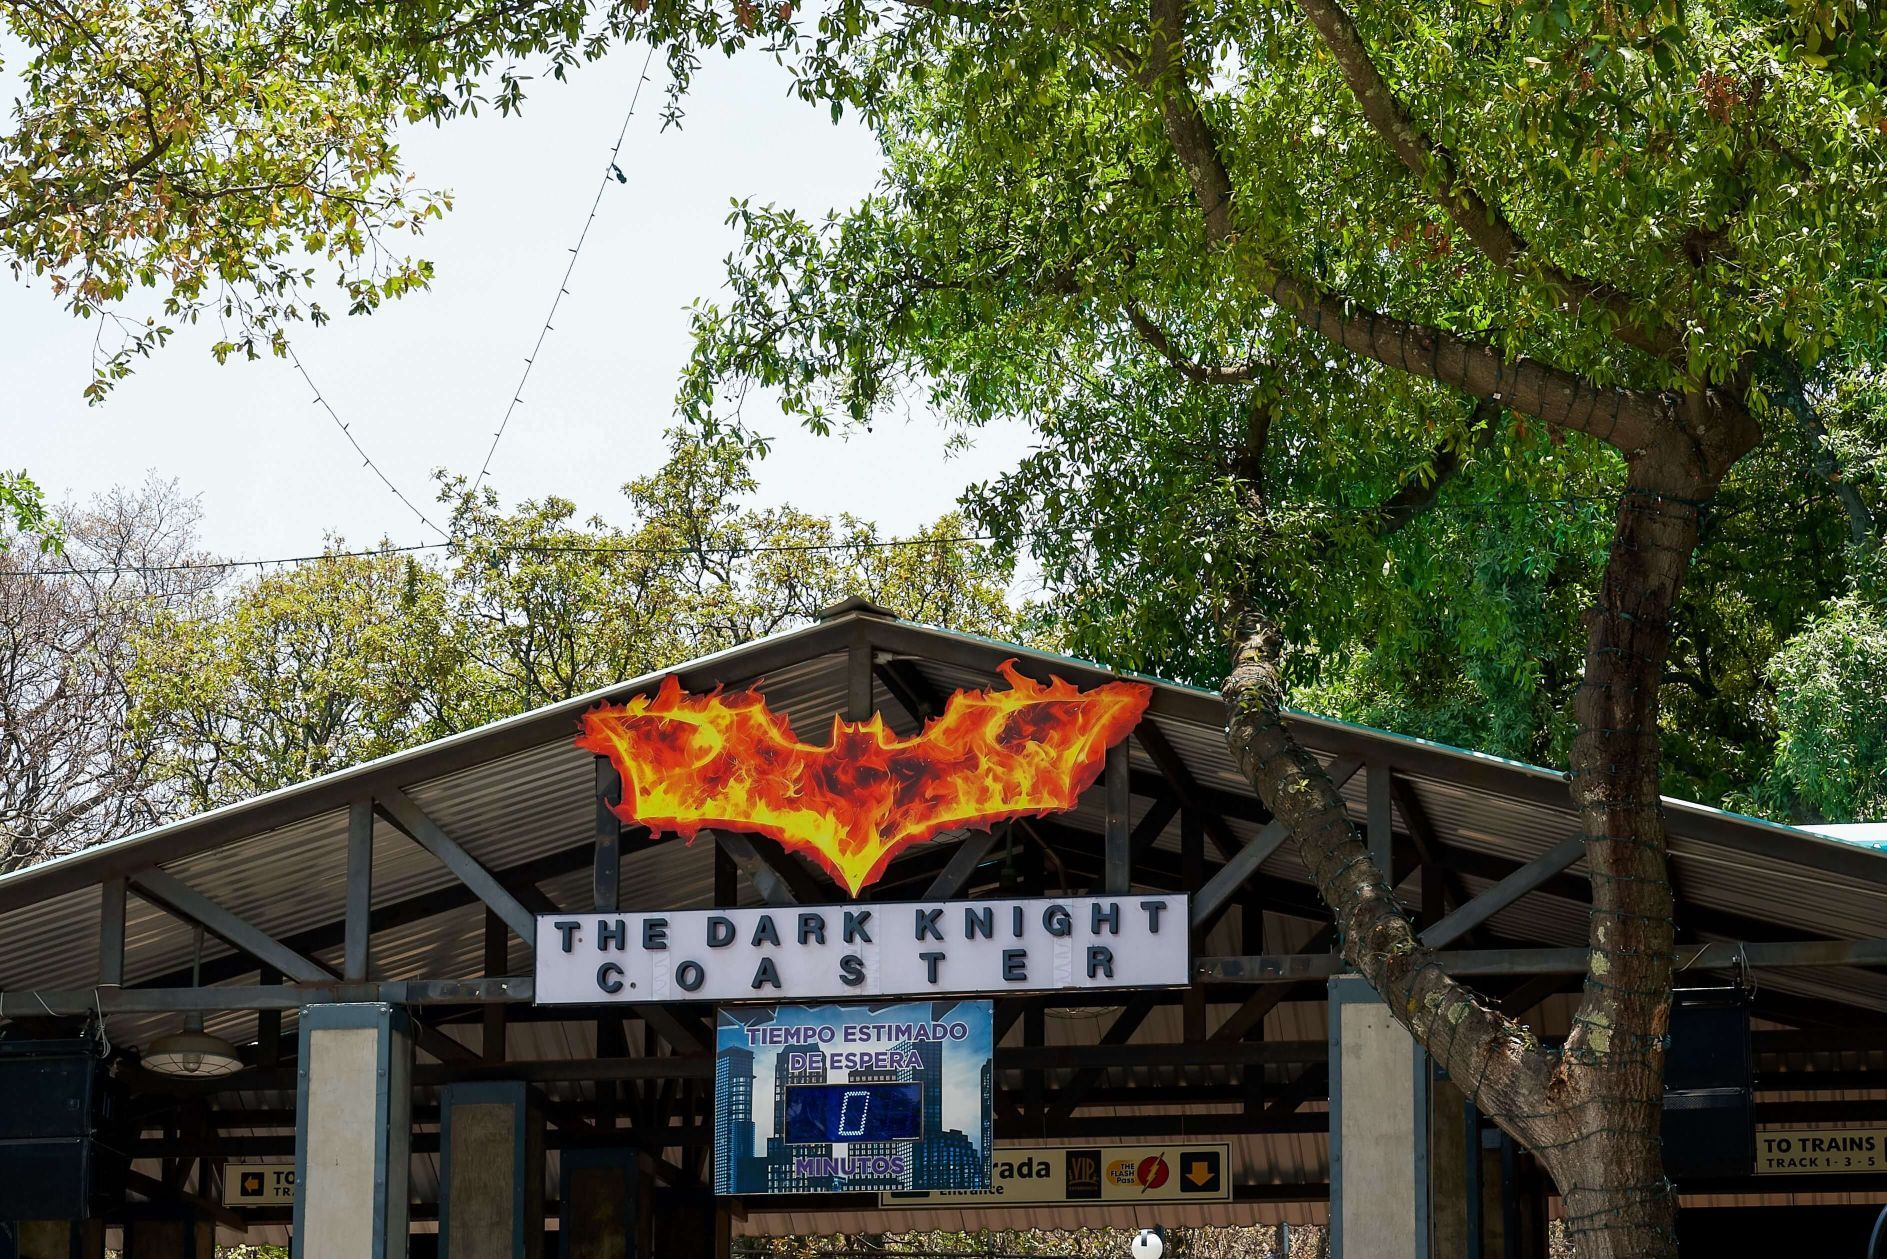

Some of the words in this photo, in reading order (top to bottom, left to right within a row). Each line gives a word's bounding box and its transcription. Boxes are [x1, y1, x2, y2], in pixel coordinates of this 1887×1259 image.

[554, 917, 669, 953] THE
[706, 911, 873, 948] DARK
[915, 901, 1167, 941] KNIGHT
[596, 946, 1115, 994] COASTER
[746, 1025, 836, 1045] TIEMPO
[843, 1022, 968, 1042] ESTIMADO
[789, 1053, 823, 1071] DE
[830, 1050, 924, 1070] ESPERA
[838, 1091, 870, 1136] 0
[1763, 1138, 1792, 1153] TO
[1798, 1136, 1876, 1152] TRAINS
[795, 1156, 905, 1177] MINUTOS
[1071, 1157, 1096, 1180] VIP
[1766, 1158, 1818, 1168] TRACK
[273, 1171, 295, 1185] TO
[273, 1187, 294, 1197] TR
